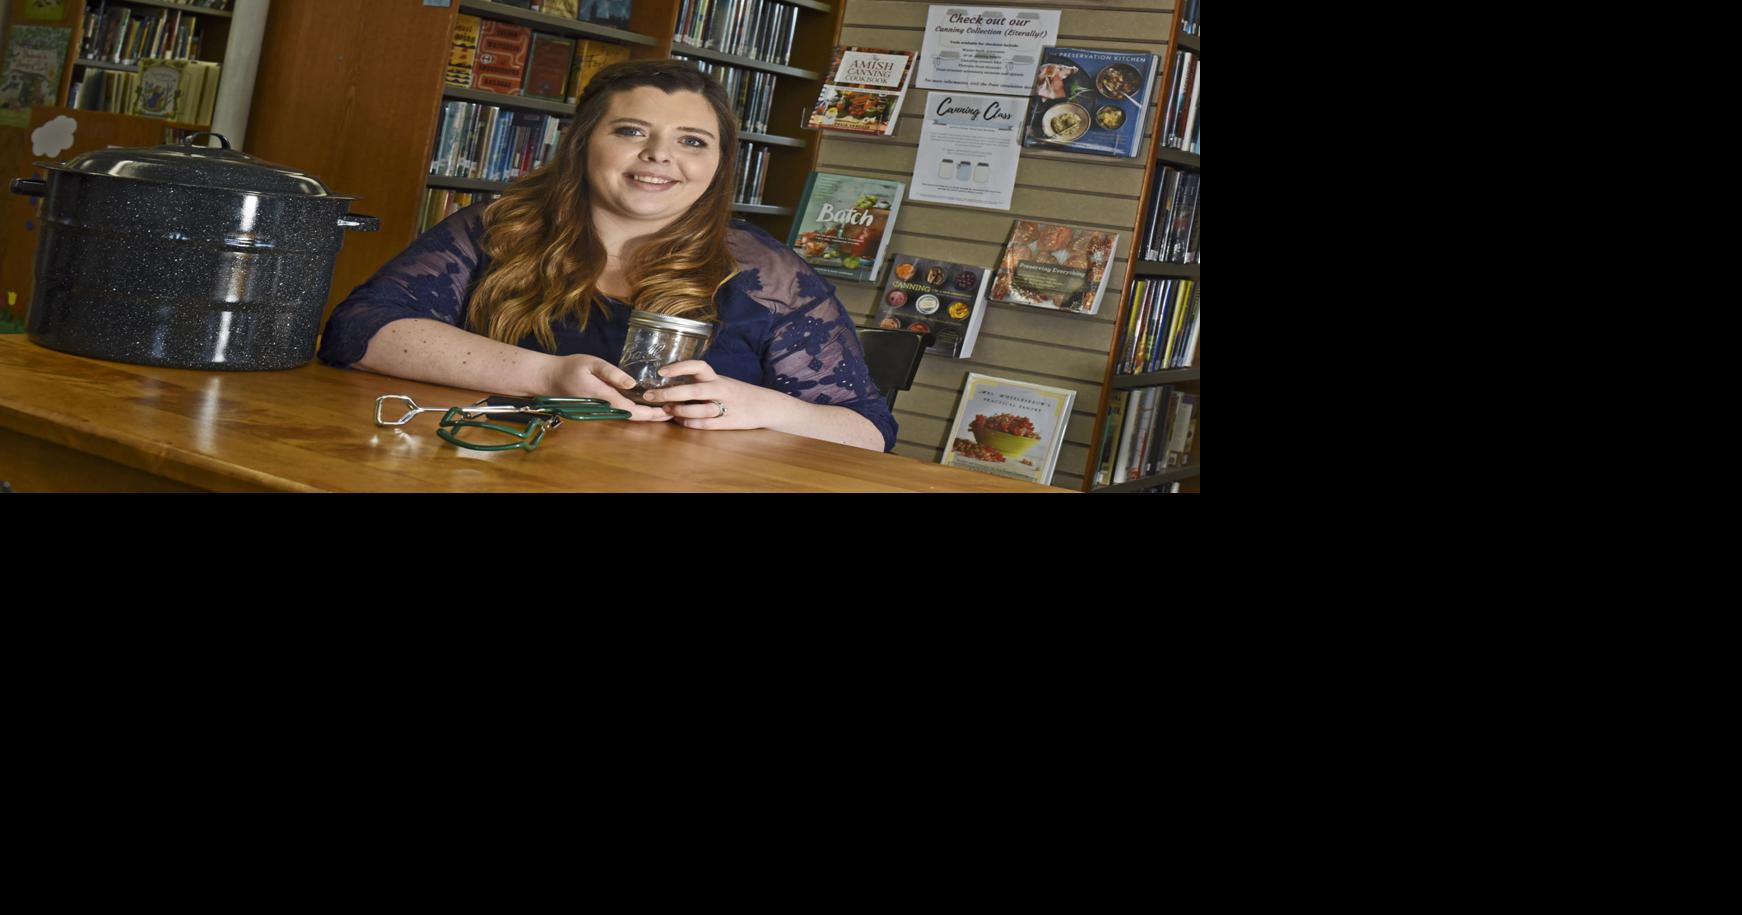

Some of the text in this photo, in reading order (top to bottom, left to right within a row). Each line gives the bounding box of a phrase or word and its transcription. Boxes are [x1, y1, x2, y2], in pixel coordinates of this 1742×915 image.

[949, 13, 983, 25] Check
[986, 17, 1006, 26] out
[934, 26, 1048, 38] Canning Collection (Literally!)
[1058, 52, 1112, 60] PRESERVATION
[850, 60, 894, 70] AMISH
[847, 68, 892, 78] CANNING
[845, 76, 888, 84] COOKBOOK
[936, 97, 1012, 120] Canning Class
[816, 202, 874, 226] Batch
[1020, 262, 1086, 278] Preserving Everything
[892, 280, 931, 293] CANNING
